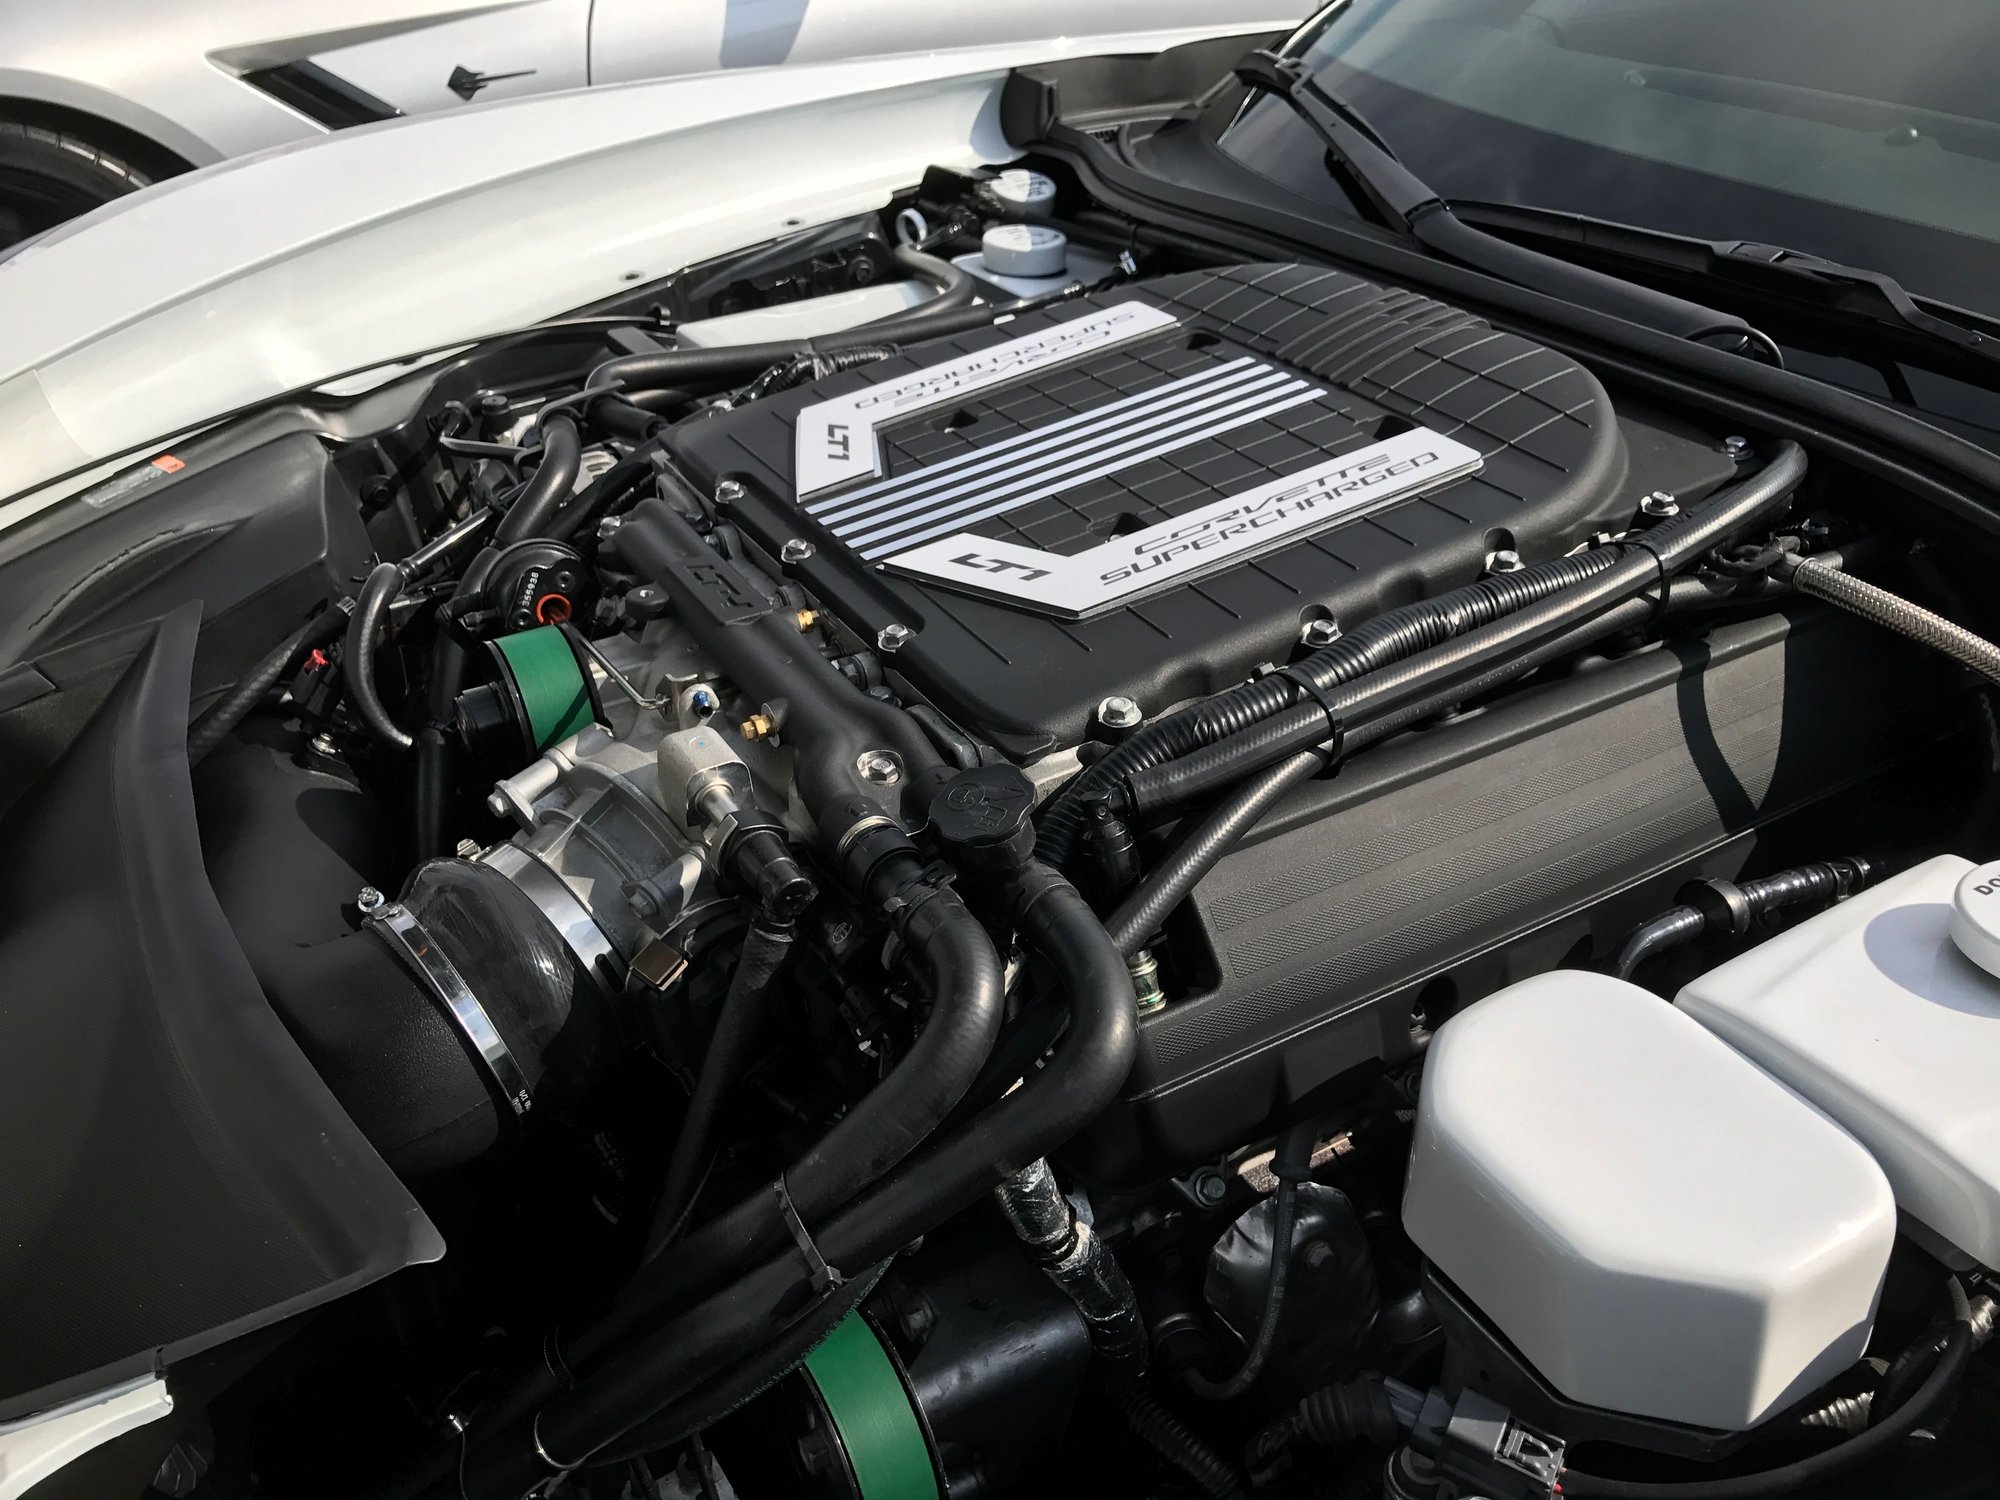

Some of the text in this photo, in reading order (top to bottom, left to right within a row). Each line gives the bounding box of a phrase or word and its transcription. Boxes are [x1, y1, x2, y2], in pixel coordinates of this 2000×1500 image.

[855, 311, 1136, 410] SUPERCHARGED
[894, 329, 1111, 408] CORVETTE
[827, 423, 850, 461] LT1
[1100, 451, 1439, 586] SUPERCHARGED
[1134, 453, 1390, 556] CORVETTE
[521, 571, 540, 608] 355938
[948, 552, 1054, 582] LT1
